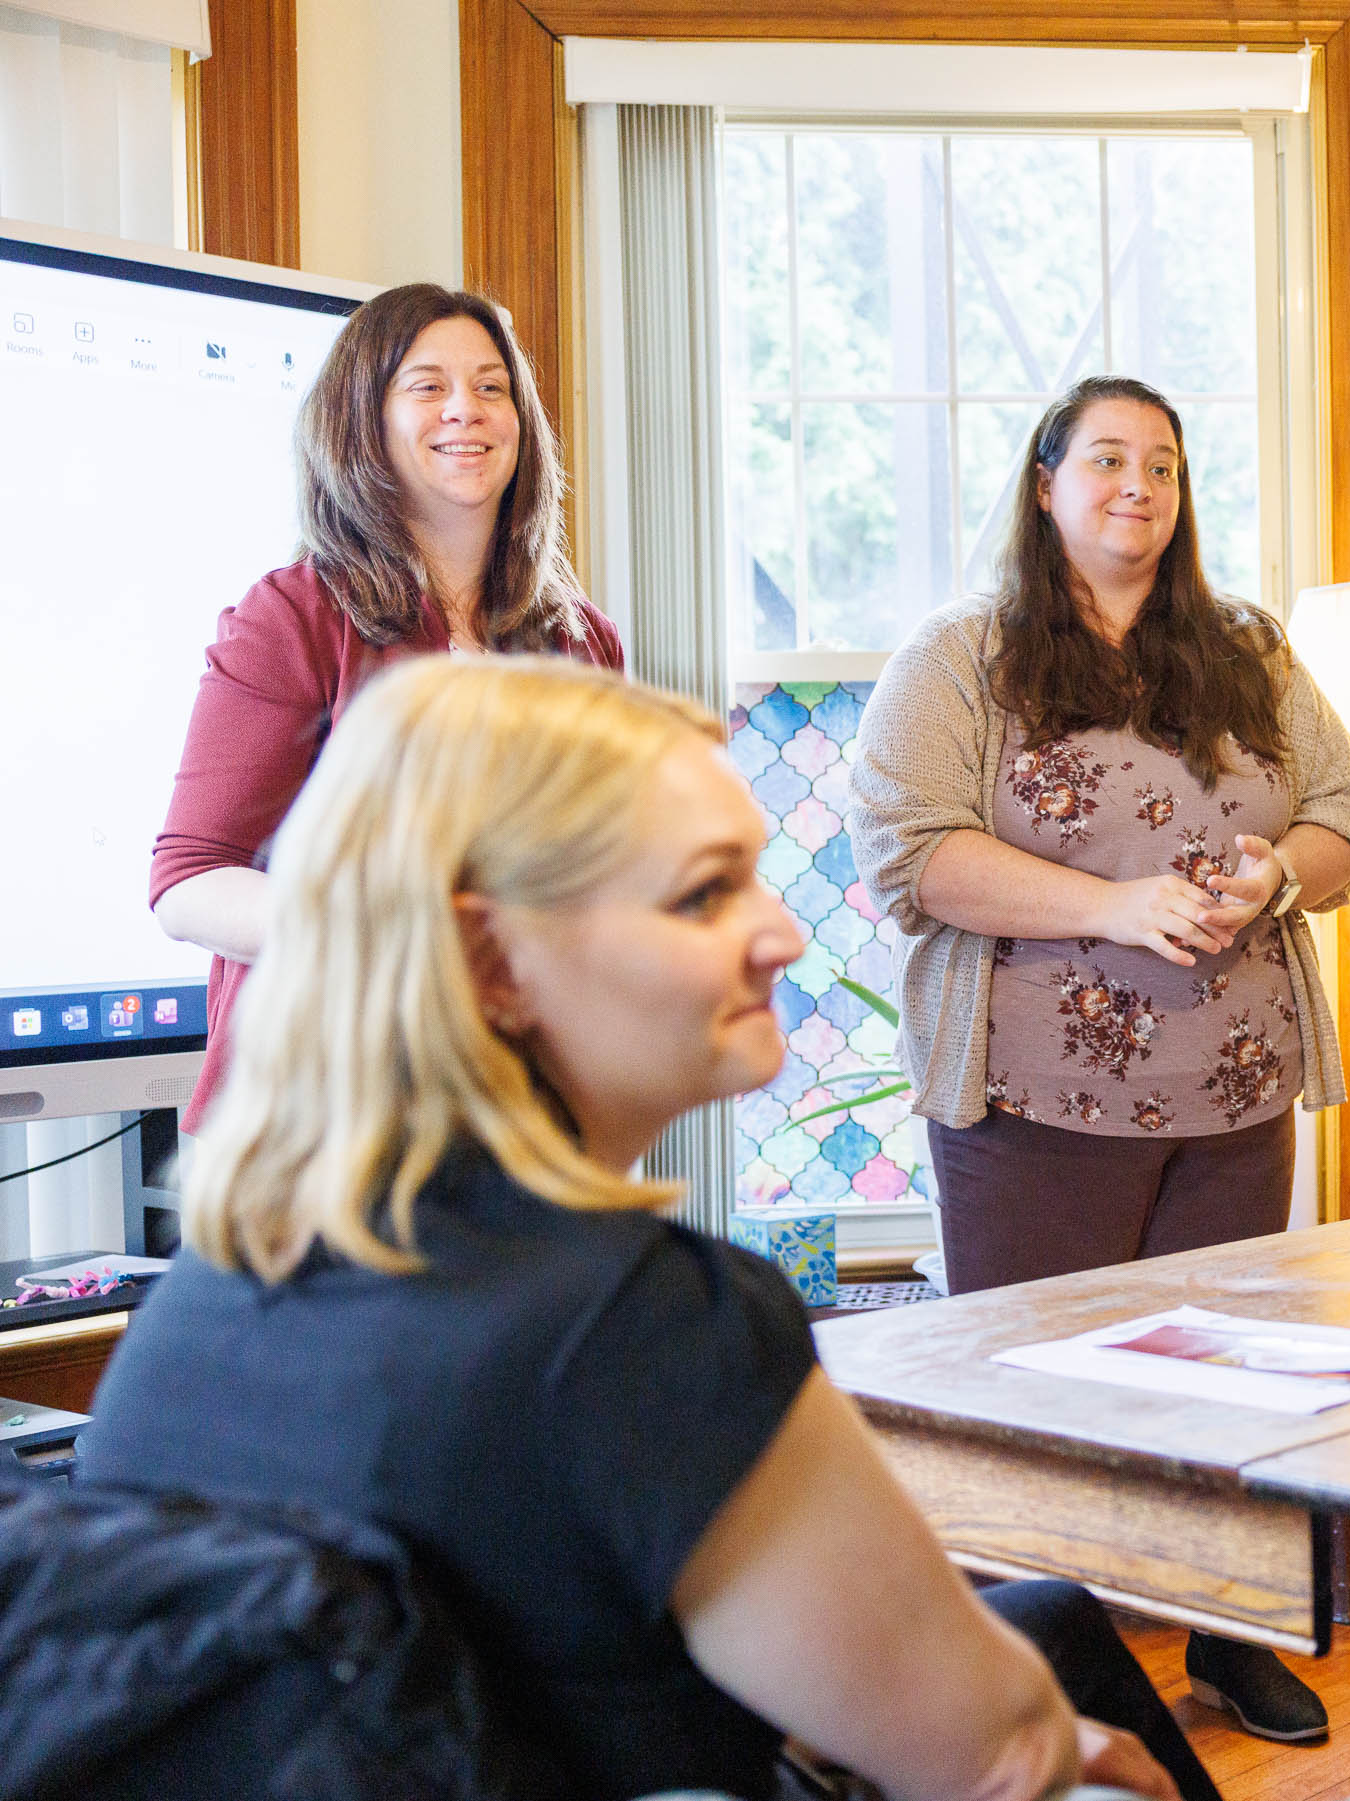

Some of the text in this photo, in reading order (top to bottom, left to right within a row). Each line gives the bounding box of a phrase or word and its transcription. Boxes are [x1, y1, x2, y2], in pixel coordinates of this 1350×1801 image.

[6, 342, 43, 357] Rooms
[72, 351, 99, 365] Apps
[130, 359, 157, 371] More
[198, 368, 236, 384] Camera
[127, 999, 136, 1011] 2
